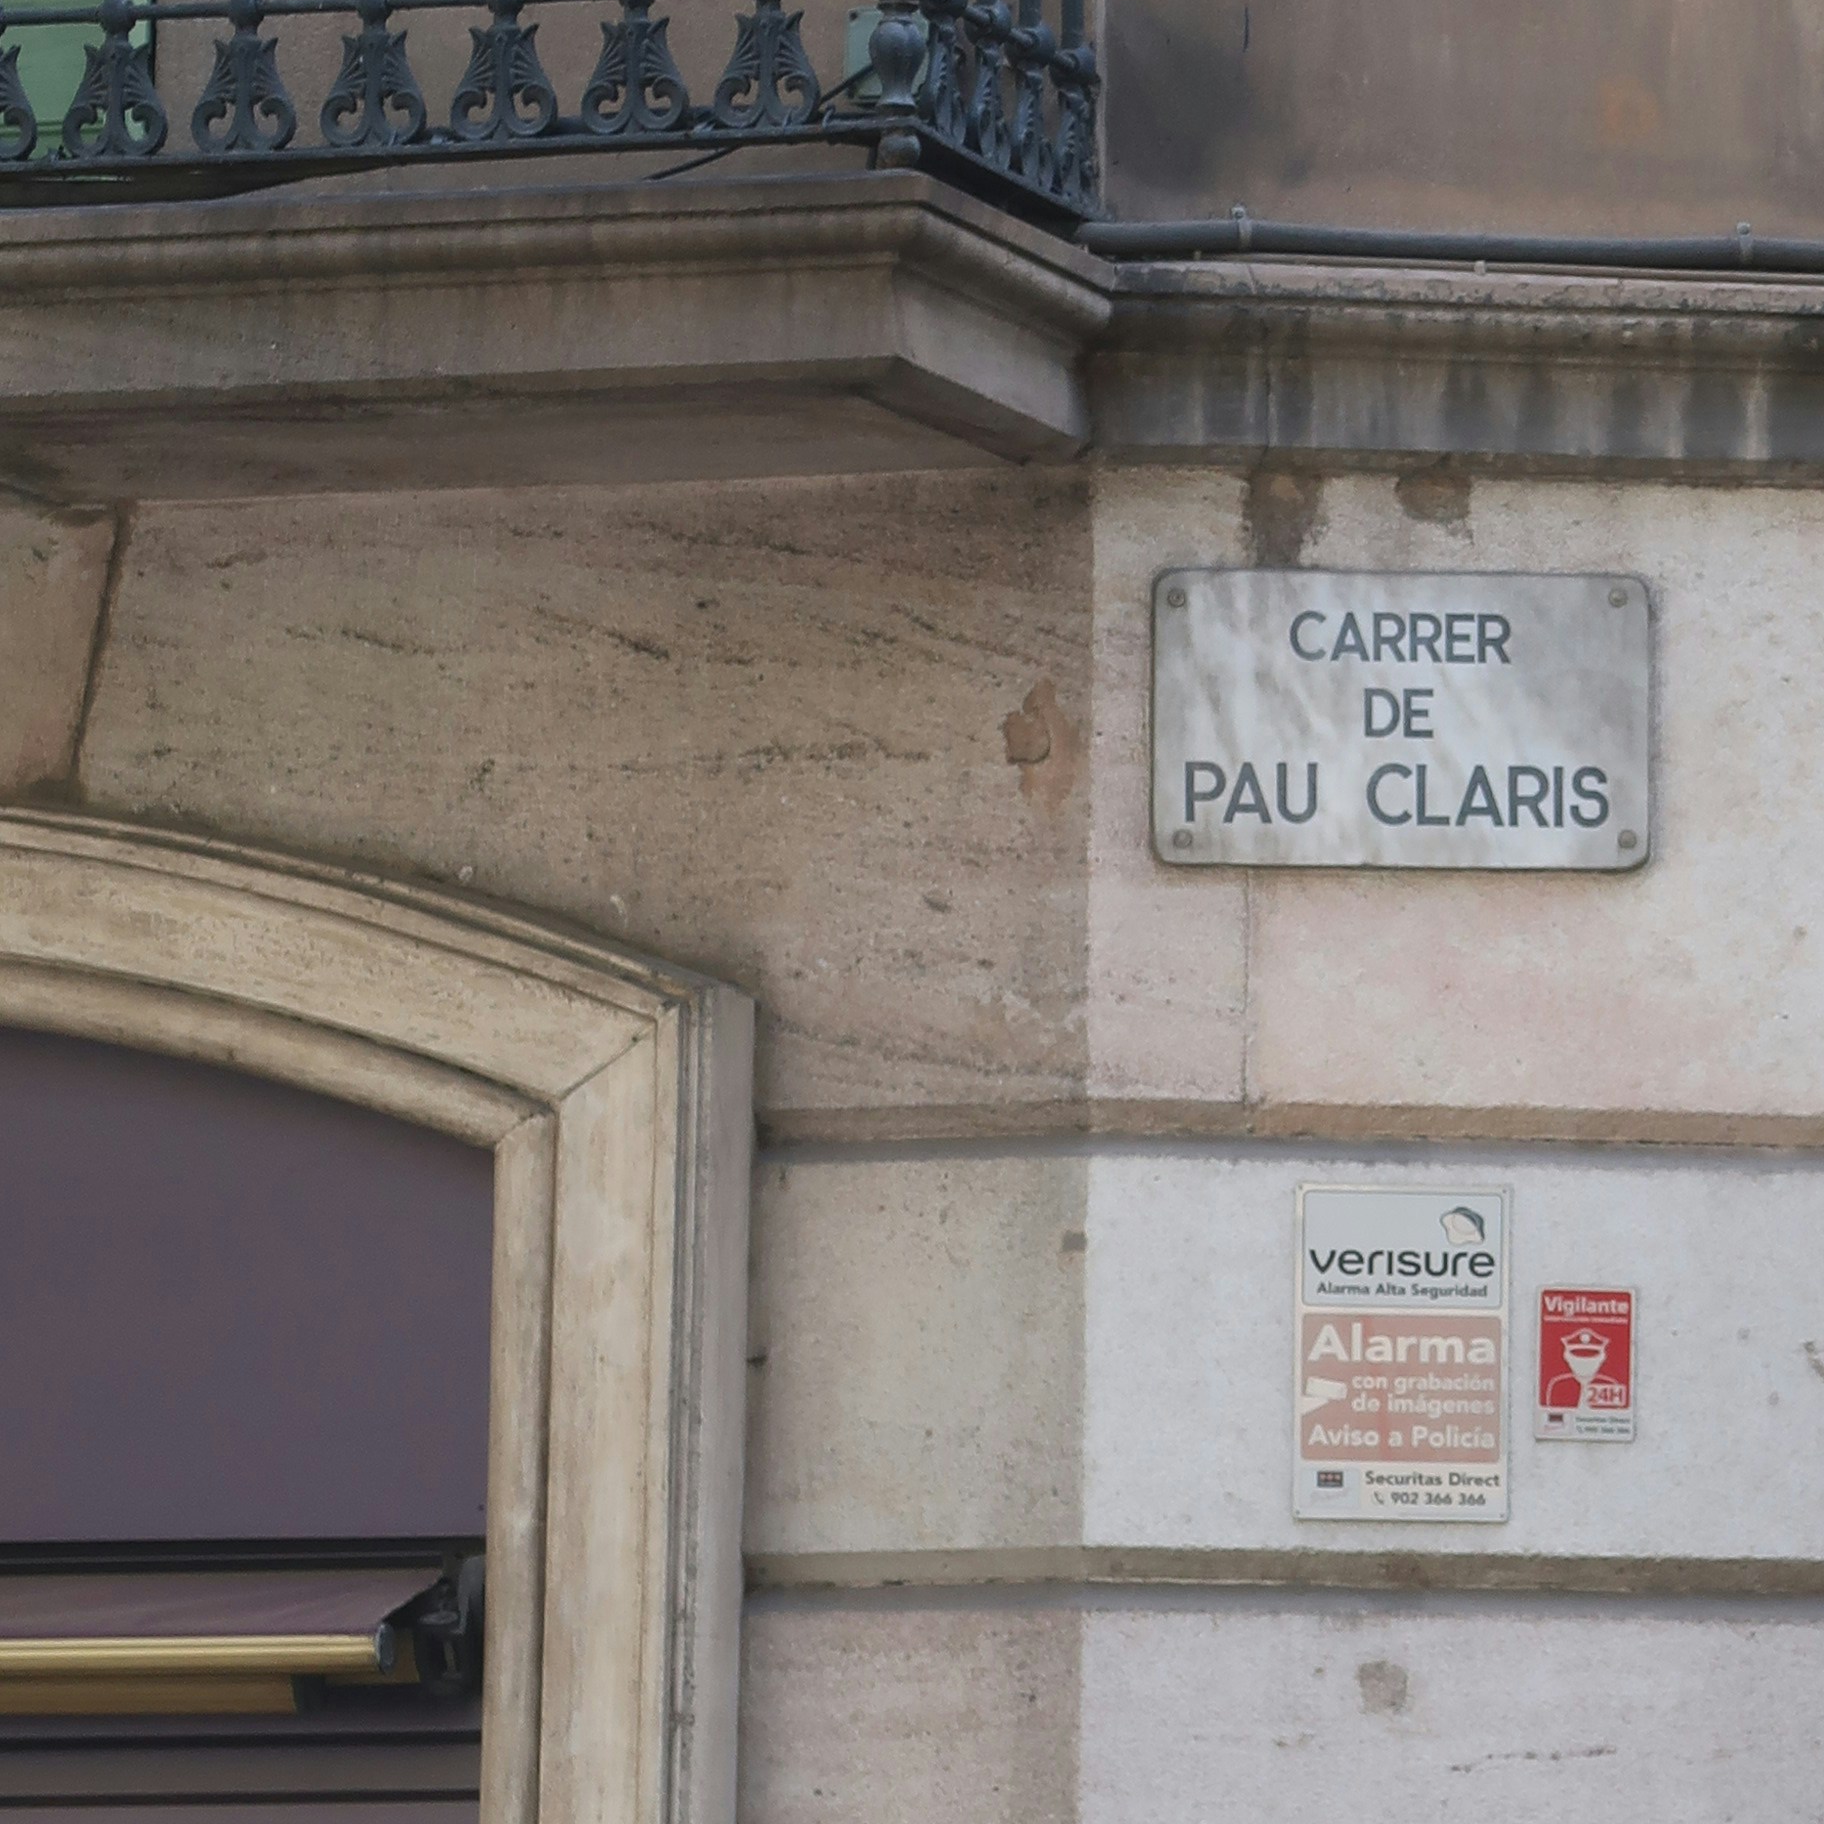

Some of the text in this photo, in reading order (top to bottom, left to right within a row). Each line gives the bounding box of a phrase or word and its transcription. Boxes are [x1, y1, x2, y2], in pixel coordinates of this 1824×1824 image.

[1289, 610, 1511, 664] CARRER
[1363, 687, 1434, 739] DE
[1184, 761, 1609, 827] PAU CLARIS
[1309, 1249, 1495, 1277] verisure
[1317, 1281, 1488, 1300] Alarma Alta Seguridad
[1544, 1296, 1629, 1316] Vigilante
[1307, 1322, 1496, 1363] Alarma
[1352, 1372, 1495, 1394] con grabación
[1351, 1392, 1495, 1419] de imágenes
[1587, 1386, 1623, 1405] 24H
[1308, 1424, 1496, 1448] Aviso a Policía
[1365, 1470, 1501, 1488] Securitas Direct
[1390, 1492, 1486, 1506] 902 366 366
